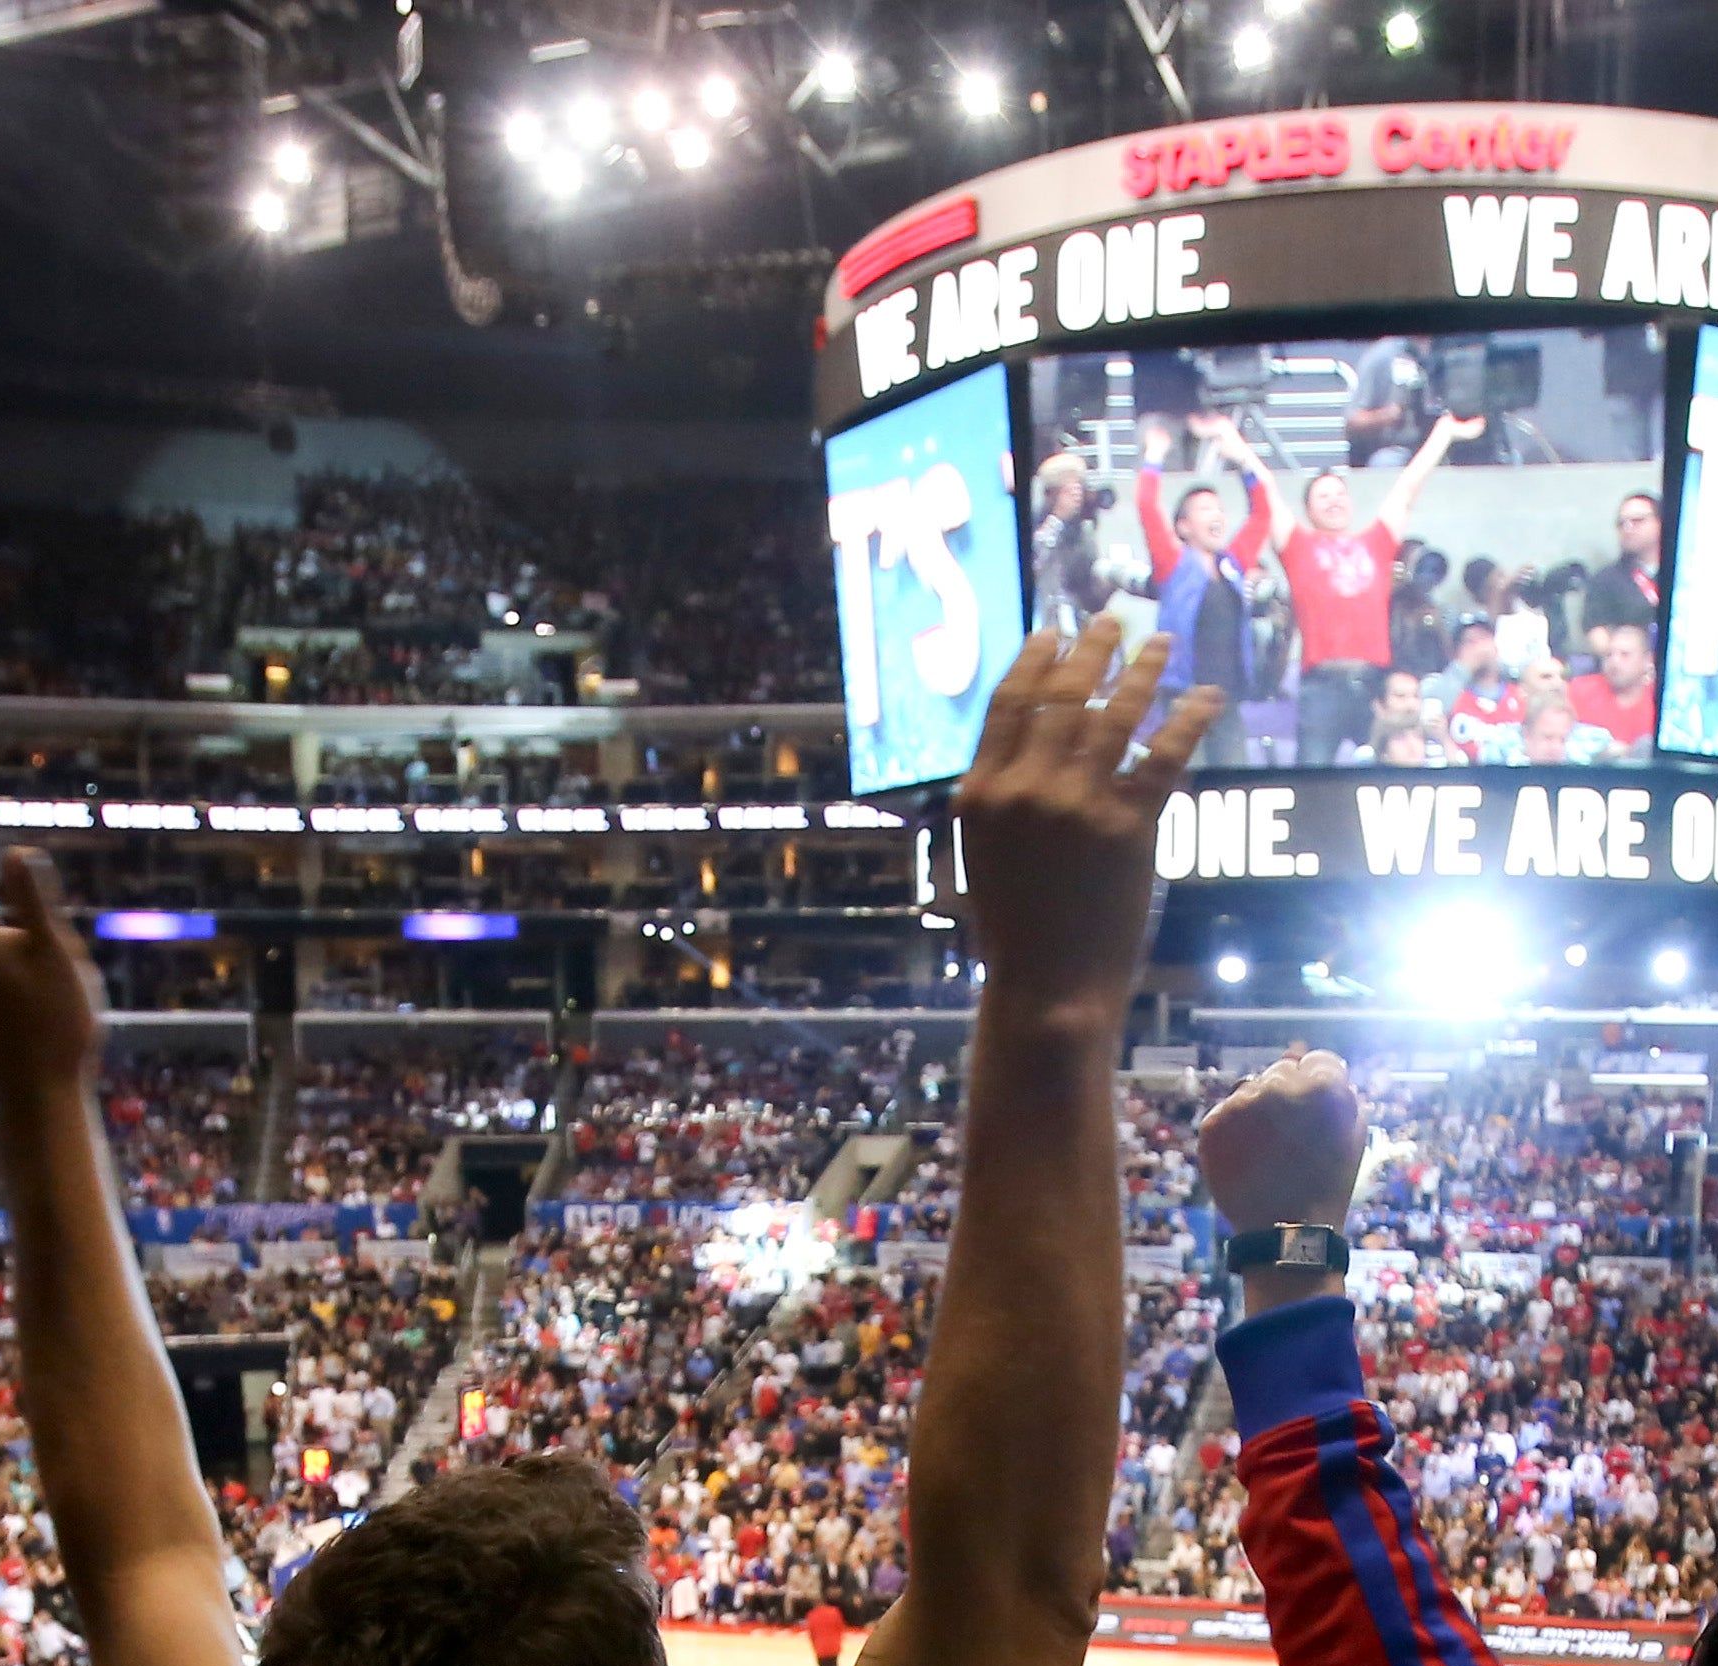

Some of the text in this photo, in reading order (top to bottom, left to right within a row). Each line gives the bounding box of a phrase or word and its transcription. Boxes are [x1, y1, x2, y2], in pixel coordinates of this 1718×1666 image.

[1122, 107, 1579, 198] STAPLES Center
[1442, 195, 1580, 299] WE
[854, 213, 1230, 399] WE ARE ONE.
[1154, 787, 1320, 880] ONE.
[1358, 785, 1498, 877] WE
[1503, 786, 1651, 881] ARE
